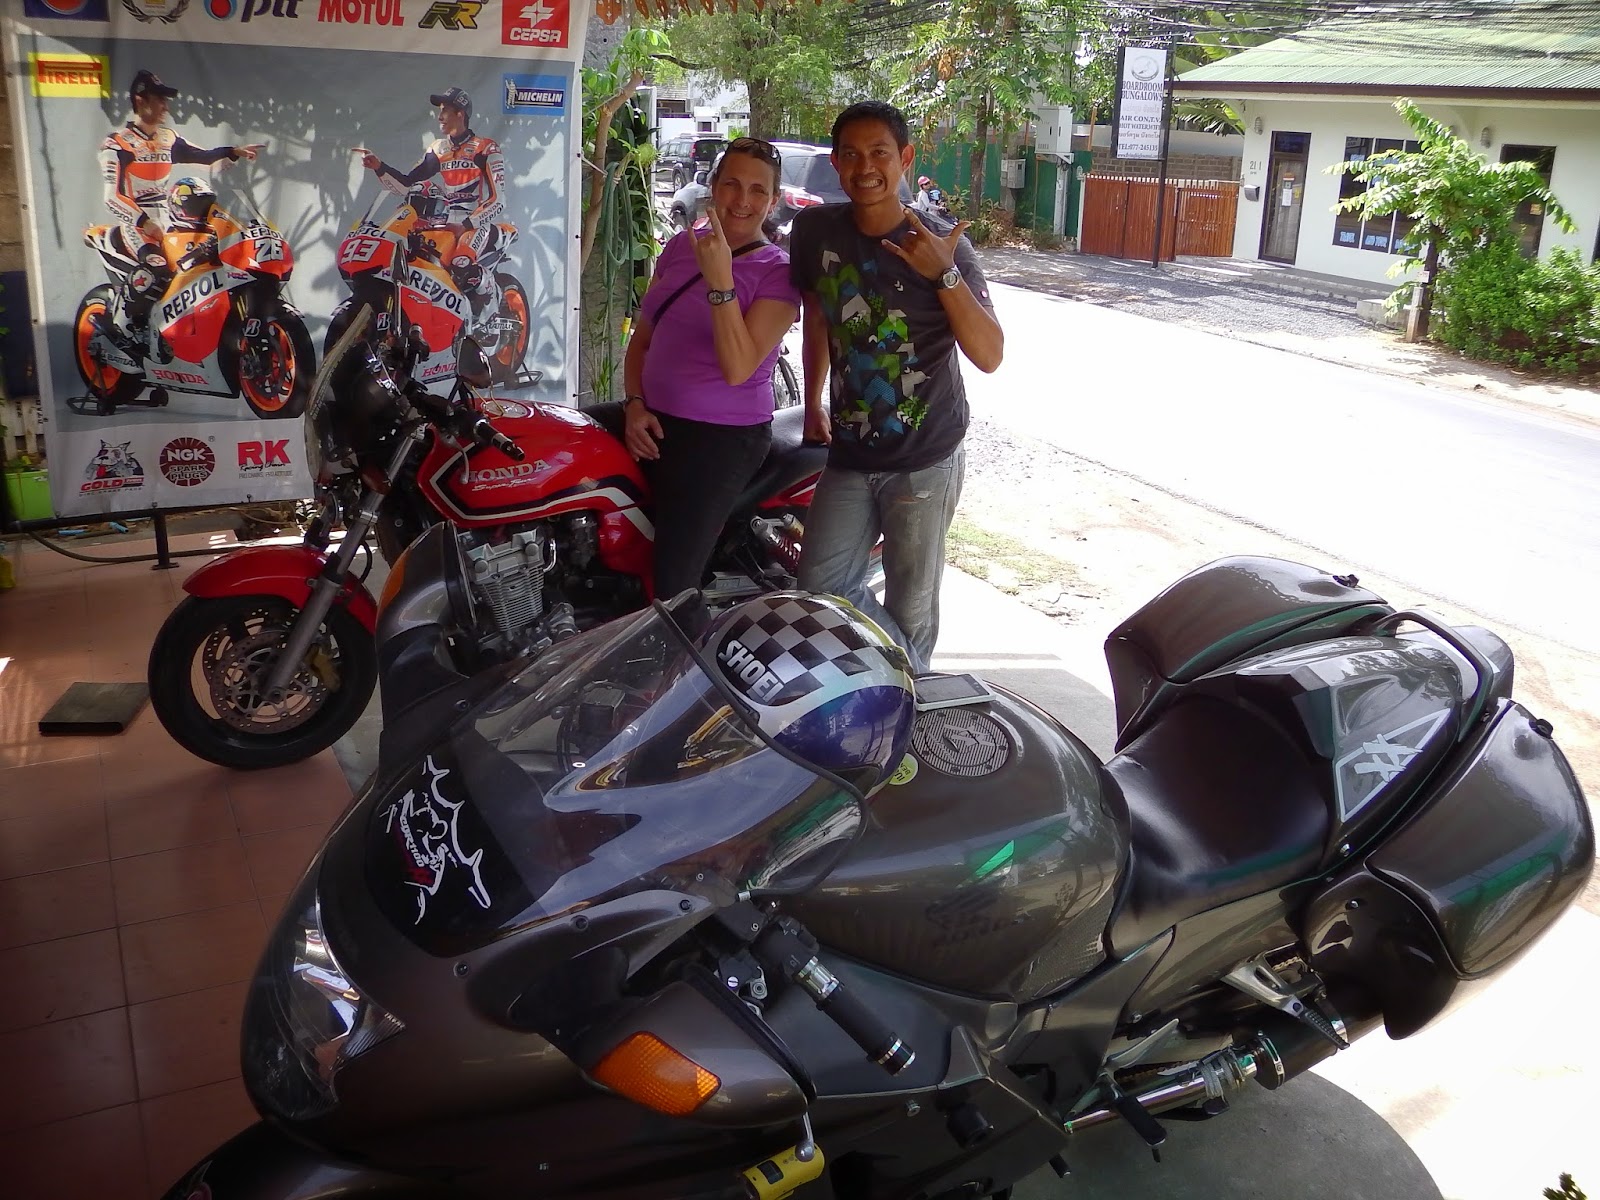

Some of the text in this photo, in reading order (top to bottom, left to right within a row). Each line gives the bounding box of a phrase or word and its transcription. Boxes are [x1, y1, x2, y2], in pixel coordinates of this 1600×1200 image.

[317, 0, 404, 27] MOTUL
[509, 27, 562, 43] CEPSA
[37, 60, 103, 85] PIRELLI
[1122, 80, 1163, 92] BOARDROOM
[517, 90, 563, 103] MICHELIN
[1121, 90, 1164, 101] BUNGALOWS
[441, 160, 476, 171] REPSOL
[254, 238, 284, 263] 26
[339, 238, 381, 265] 93
[162, 271, 224, 324] REPSOL
[410, 269, 463, 315] REPSOL
[421, 361, 457, 378] HON
[166, 448, 207, 462] NGK
[237, 438, 292, 466] RK
[169, 464, 207, 472] SPARK
[170, 471, 208, 481] PLUGS
[80, 478, 124, 492] GOLD
[718, 639, 784, 702] SHOEI
